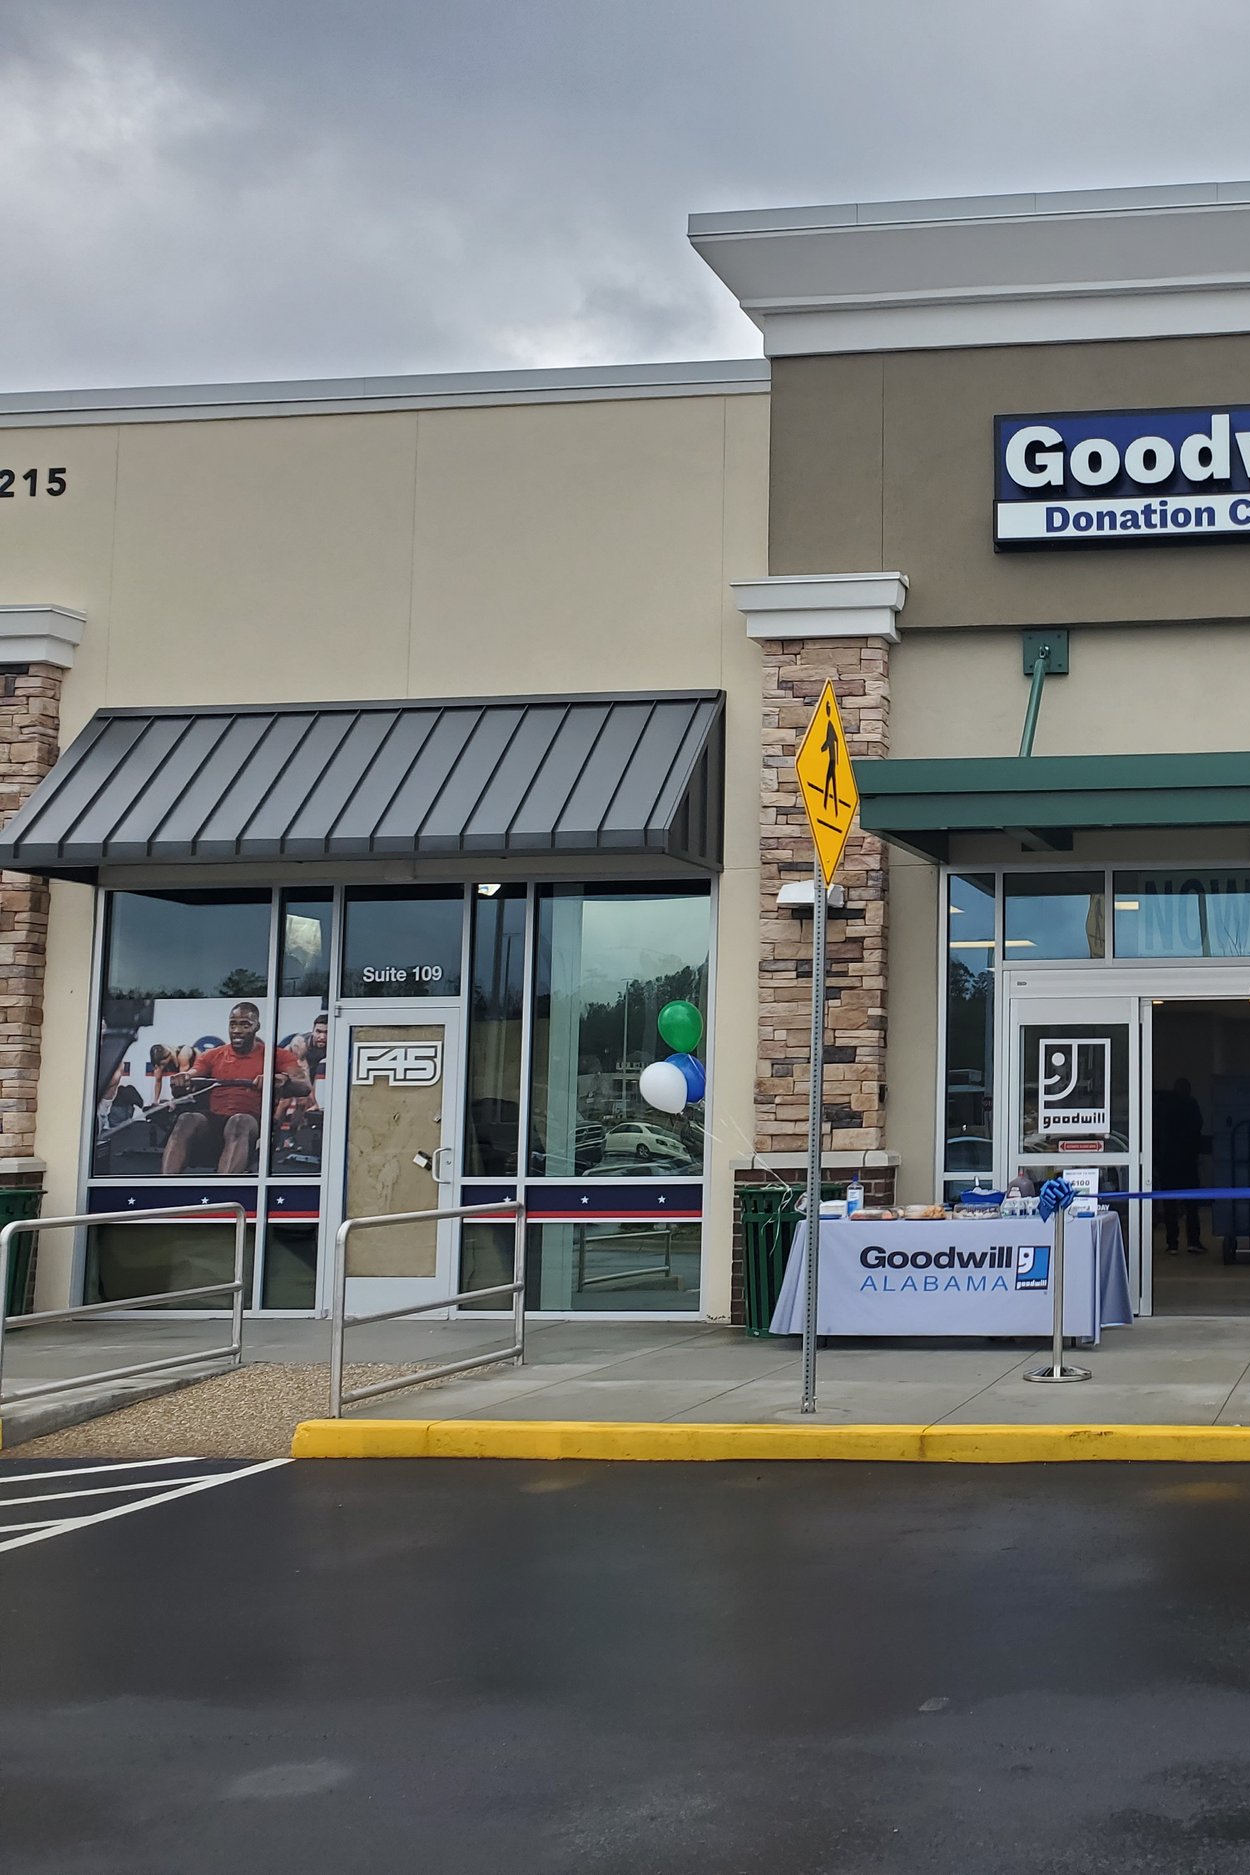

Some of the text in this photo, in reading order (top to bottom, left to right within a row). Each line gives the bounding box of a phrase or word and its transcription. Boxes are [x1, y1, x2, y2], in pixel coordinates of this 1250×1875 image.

[0, 467, 67, 498] 215
[1045, 500, 1217, 534] Donation
[363, 965, 443, 983] Suite 109
[355, 1044, 439, 1084] F45
[1043, 1112, 1106, 1129] goodwill
[859, 1246, 1013, 1270] Goodwill
[859, 1275, 1009, 1292] ALABAMA
[1016, 1279, 1048, 1290] goodwill
